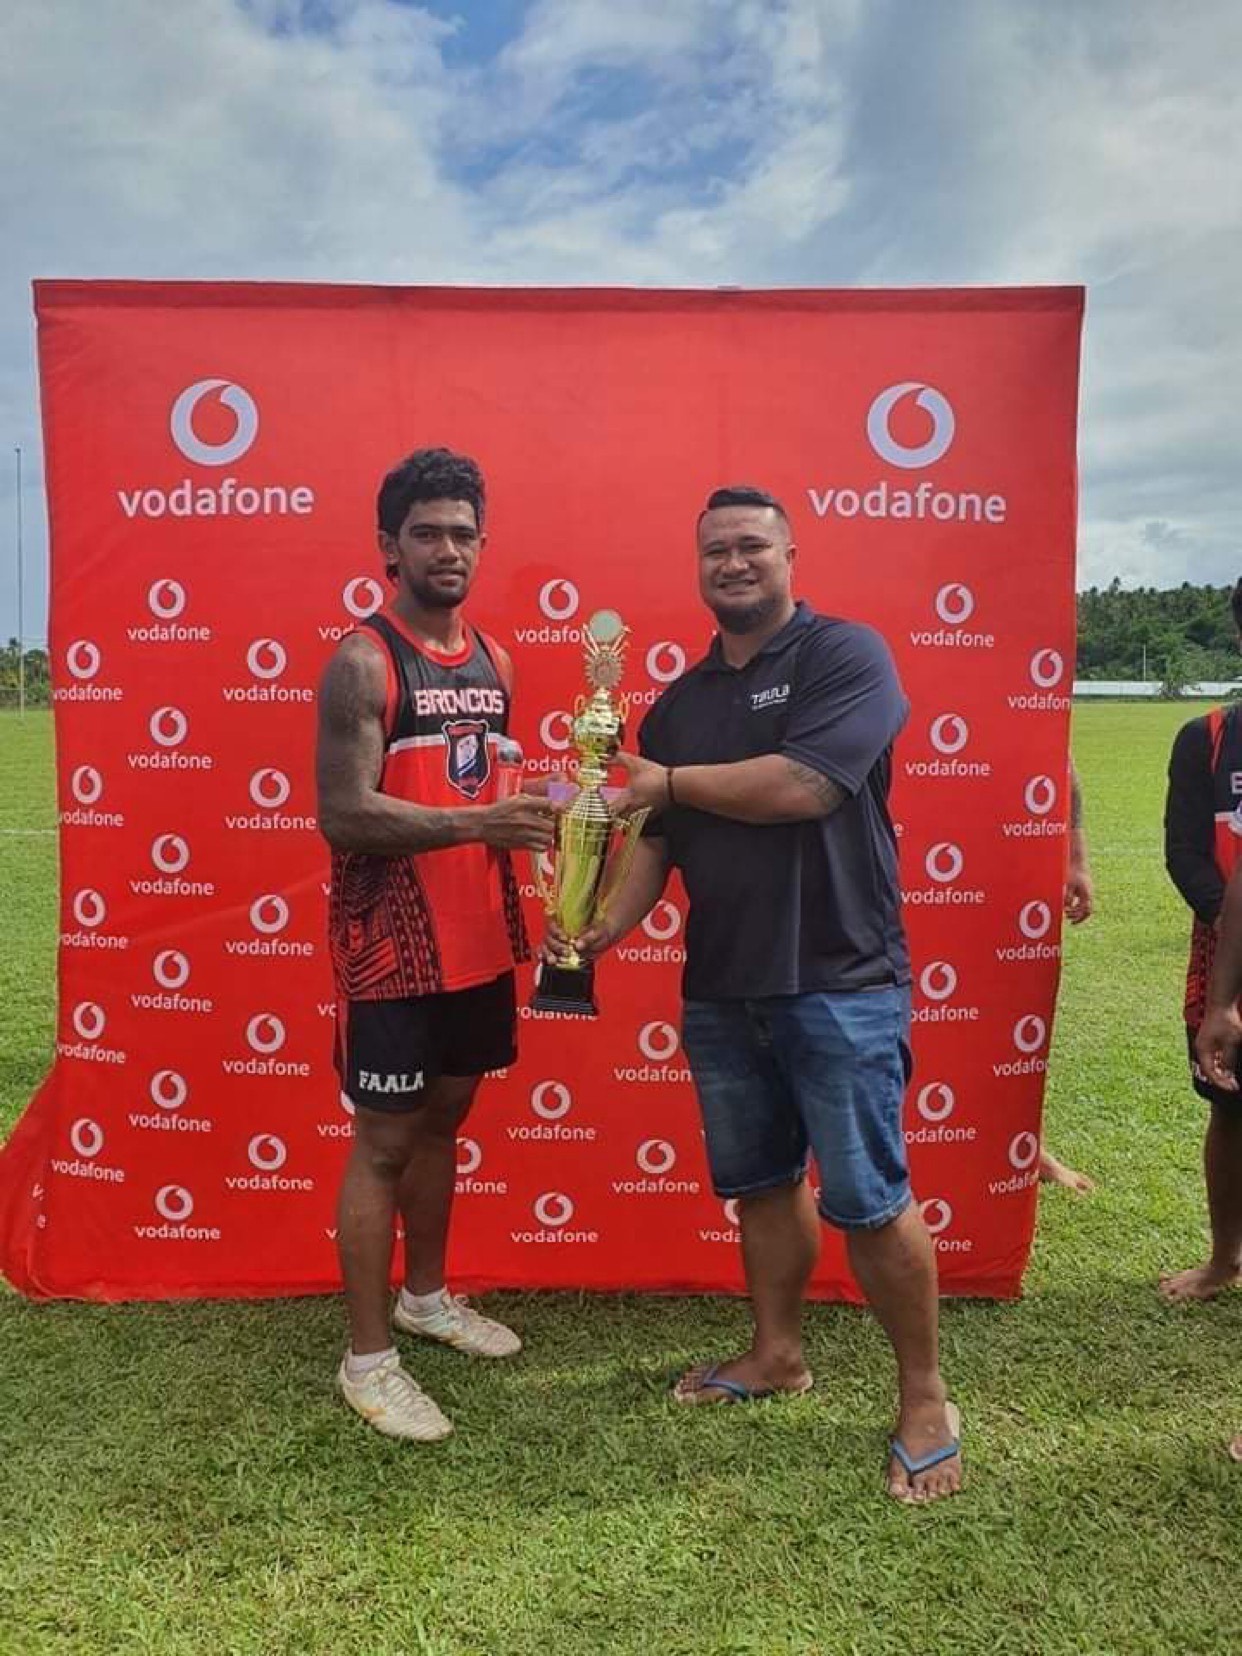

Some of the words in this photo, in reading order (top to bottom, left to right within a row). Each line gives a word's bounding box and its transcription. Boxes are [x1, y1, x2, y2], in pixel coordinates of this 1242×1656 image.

[118, 478, 315, 518] vodafone
[808, 483, 1007, 524] vodafone
[128, 623, 210, 640] vodafone
[515, 625, 585, 643] vodafo
[911, 630, 994, 647] vodafone
[223, 685, 313, 702] vodafone
[414, 688, 505, 715] BRONCOS
[1008, 693, 1069, 710] vodafon
[128, 752, 212, 768] vodafone
[523, 755, 579, 771] odafo
[906, 759, 990, 776] vodafone
[61, 808, 124, 827] odafone
[226, 813, 316, 829] vodafone
[1003, 819, 1066, 836] vodafon
[131, 878, 214, 895] vodafone
[900, 887, 984, 904] vodafone
[59, 930, 128, 949] odafone
[226, 938, 313, 956] vodafone
[617, 945, 686, 962] vodafo
[996, 943, 1060, 960] vodafon
[131, 993, 212, 1012] vodafone
[910, 1003, 979, 1022] odafone
[57, 1042, 126, 1063] vodafone
[223, 1058, 309, 1076] vodafone
[614, 1064, 692, 1082] vodafon
[993, 1056, 1048, 1077] vodafo
[359, 1070, 424, 1093] FAALA
[129, 1113, 211, 1132] vodafone
[507, 1124, 596, 1140] vodafone
[901, 1124, 977, 1144] odafone
[51, 1158, 125, 1182] vodafone
[226, 1175, 313, 1190] vodafone
[455, 1178, 507, 1194] afone
[612, 1178, 699, 1193] vodafone
[988, 1168, 1039, 1194] vodaf
[135, 1224, 220, 1239] vodafone
[511, 1228, 598, 1242] vodafone
[700, 1229, 741, 1242] voda
[933, 1237, 972, 1252] fone
